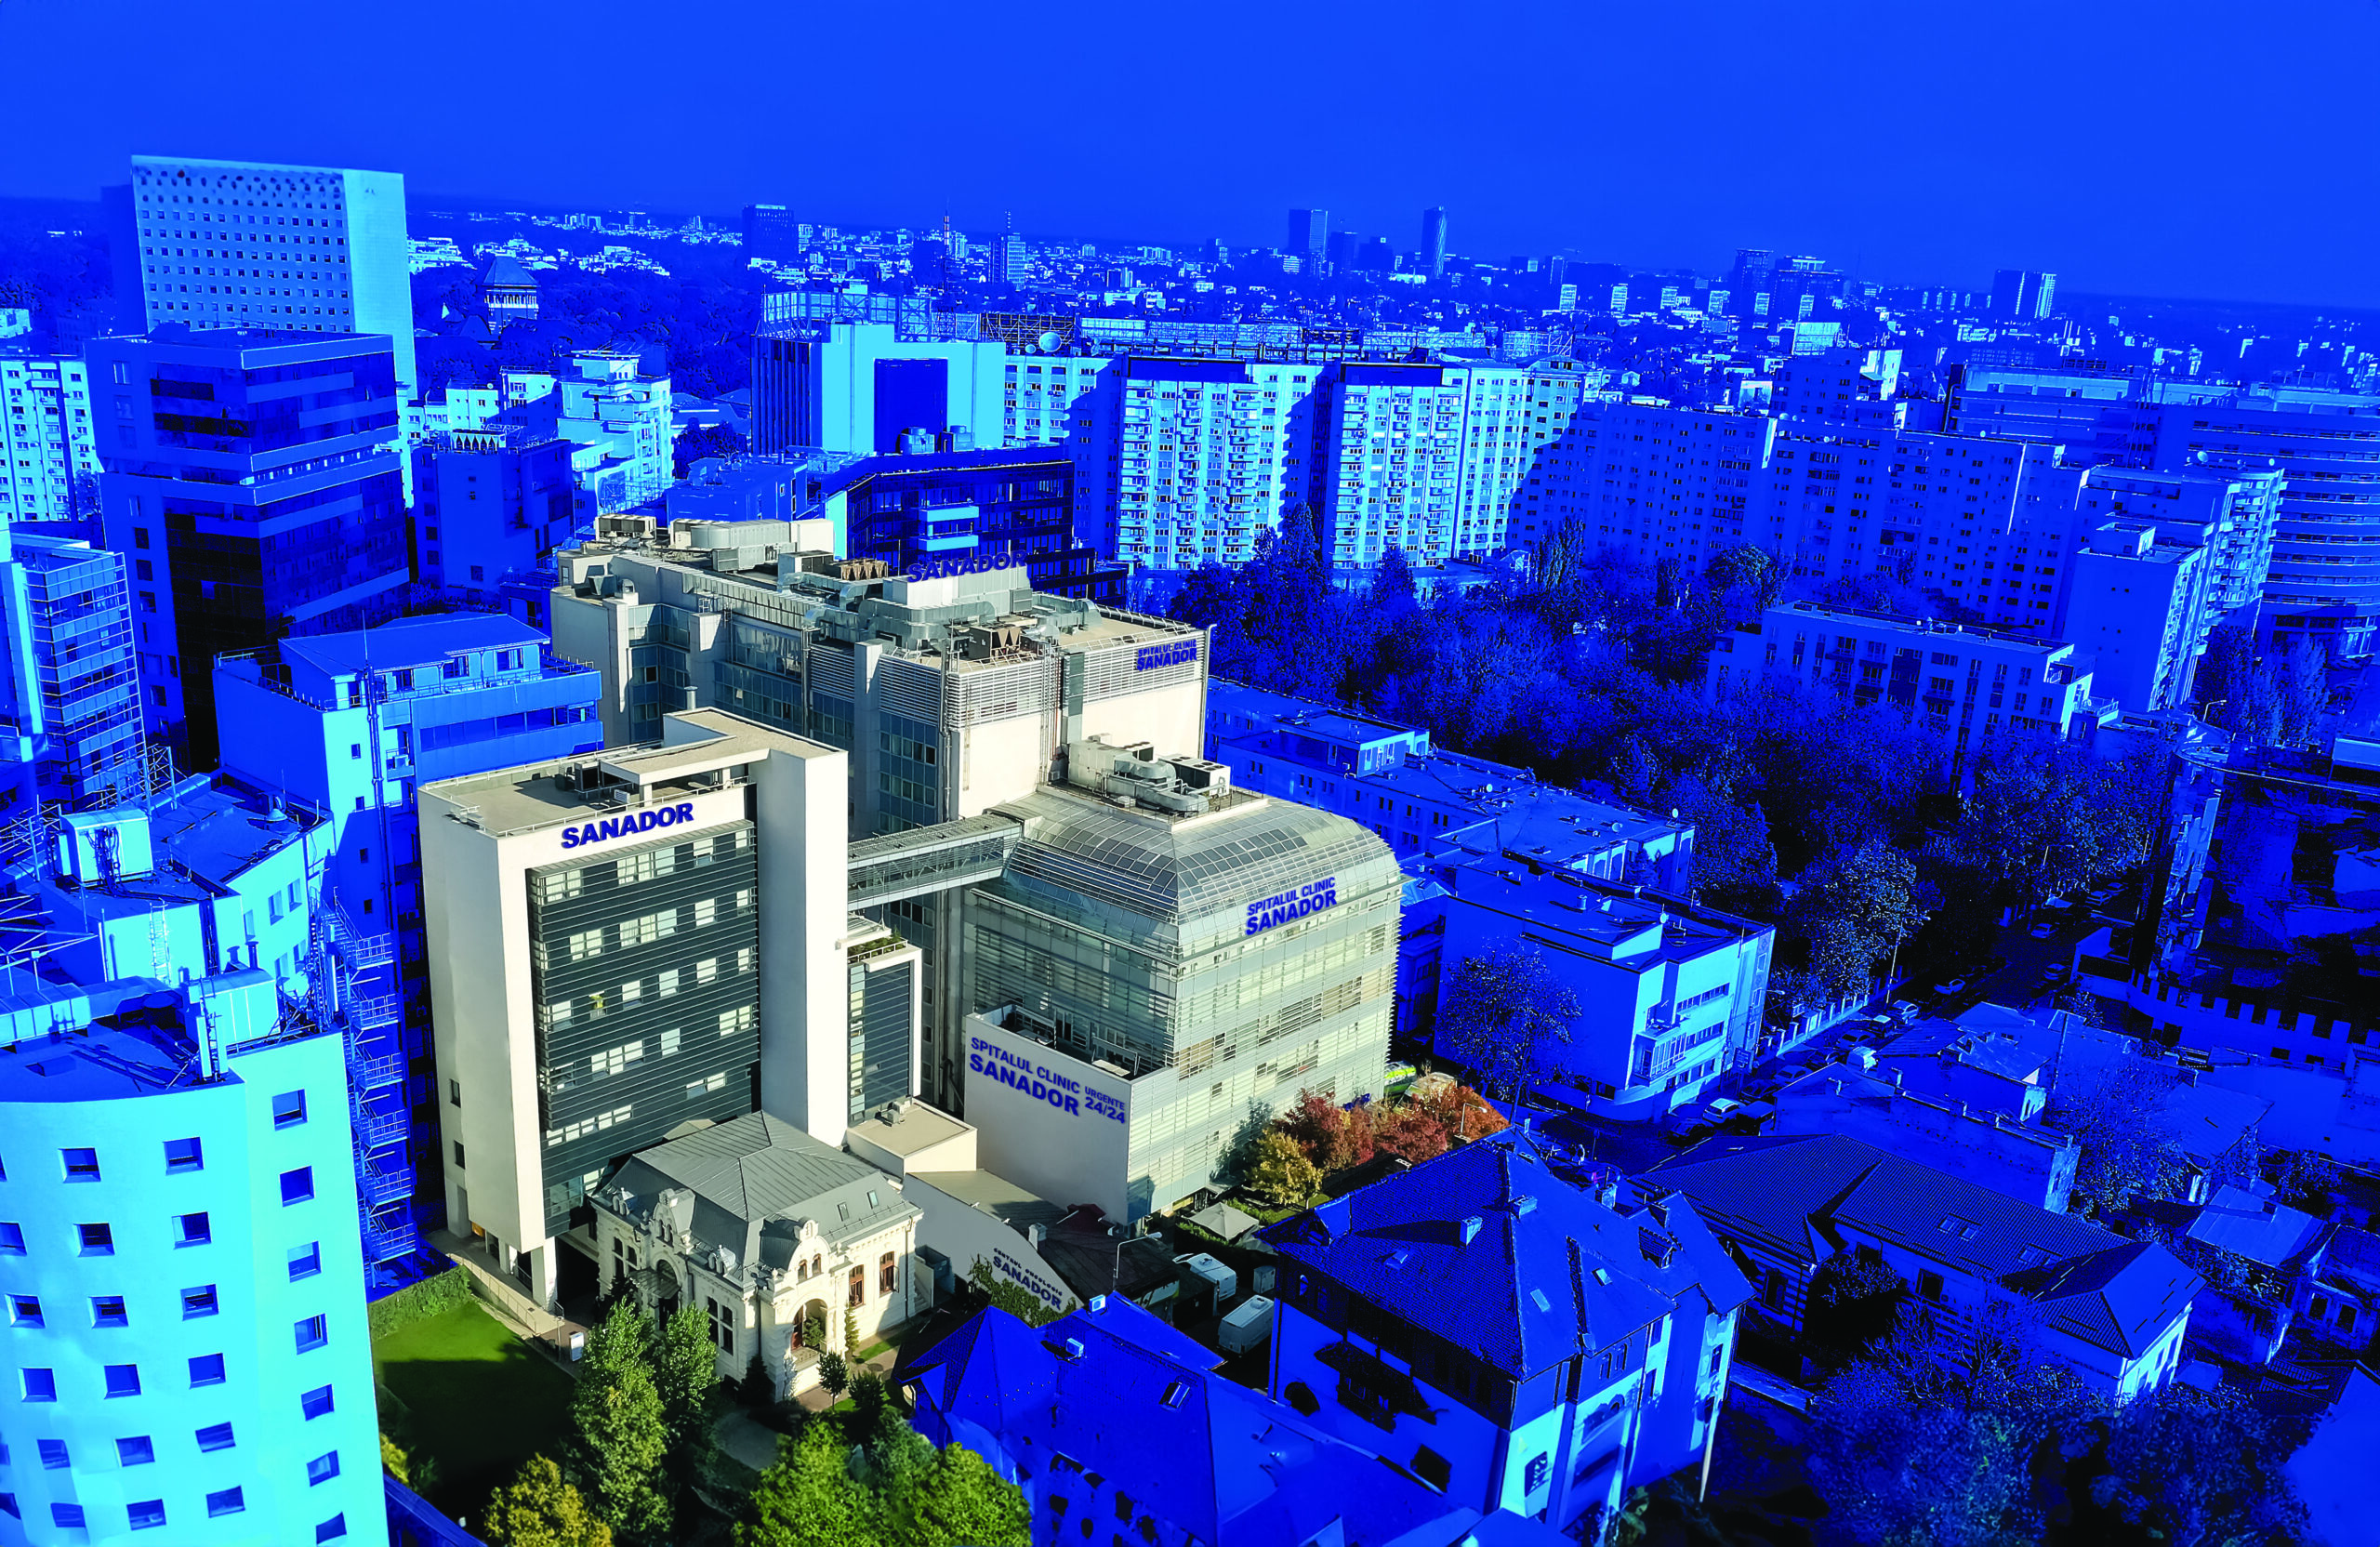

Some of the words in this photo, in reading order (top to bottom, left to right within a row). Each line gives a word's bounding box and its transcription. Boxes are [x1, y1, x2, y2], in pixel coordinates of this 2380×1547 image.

[906, 549, 1027, 583] SANADOR
[1137, 647, 1197, 671] SANADOR
[1138, 643, 1171, 657] SPITALUL
[1174, 639, 1197, 650] CLINIC
[561, 802, 694, 849] SANADOR
[1246, 889, 1338, 935] SANADOR
[1247, 889, 1300, 916] SPITALUL
[1302, 877, 1336, 897] CLINIC
[969, 1053, 1079, 1117] SANADOR
[971, 1037, 1033, 1074] SPITALUL
[1037, 1066, 1080, 1094] CLINIC
[1084, 1086, 1125, 1111] URGENTE
[1084, 1096, 1126, 1124] 24/24
[993, 1255, 1062, 1311] SANADOR
